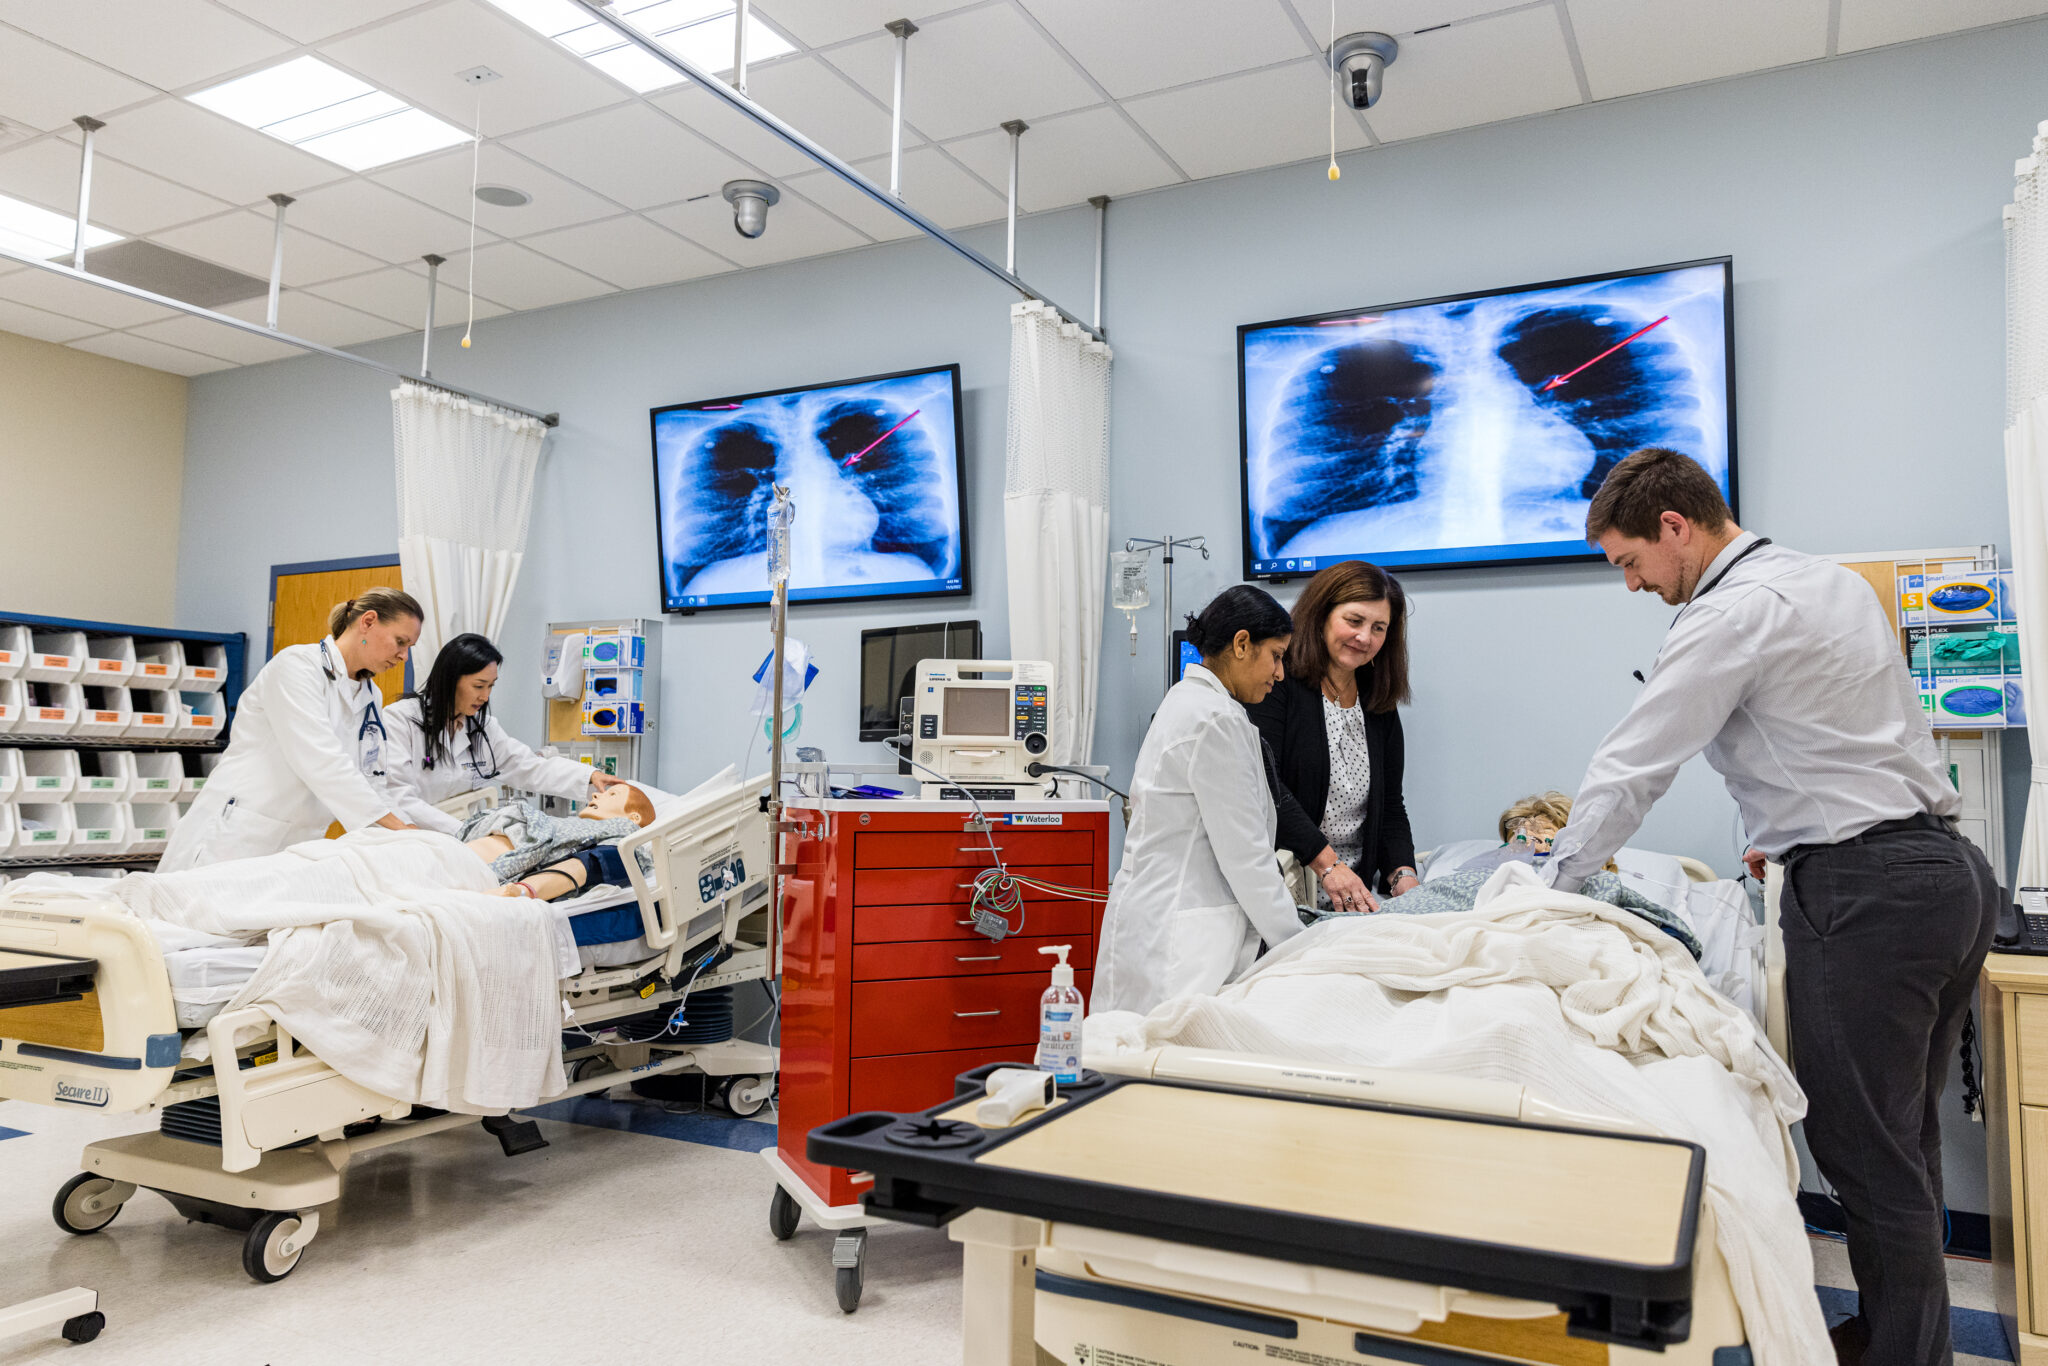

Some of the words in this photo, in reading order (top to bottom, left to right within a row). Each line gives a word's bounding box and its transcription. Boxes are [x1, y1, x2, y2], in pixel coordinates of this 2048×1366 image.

[1907, 594, 1917, 606] S
[1025, 814, 1060, 823] Waterloo
[55, 1081, 91, 1100] Secure
[92, 1086, 103, 1102] II
